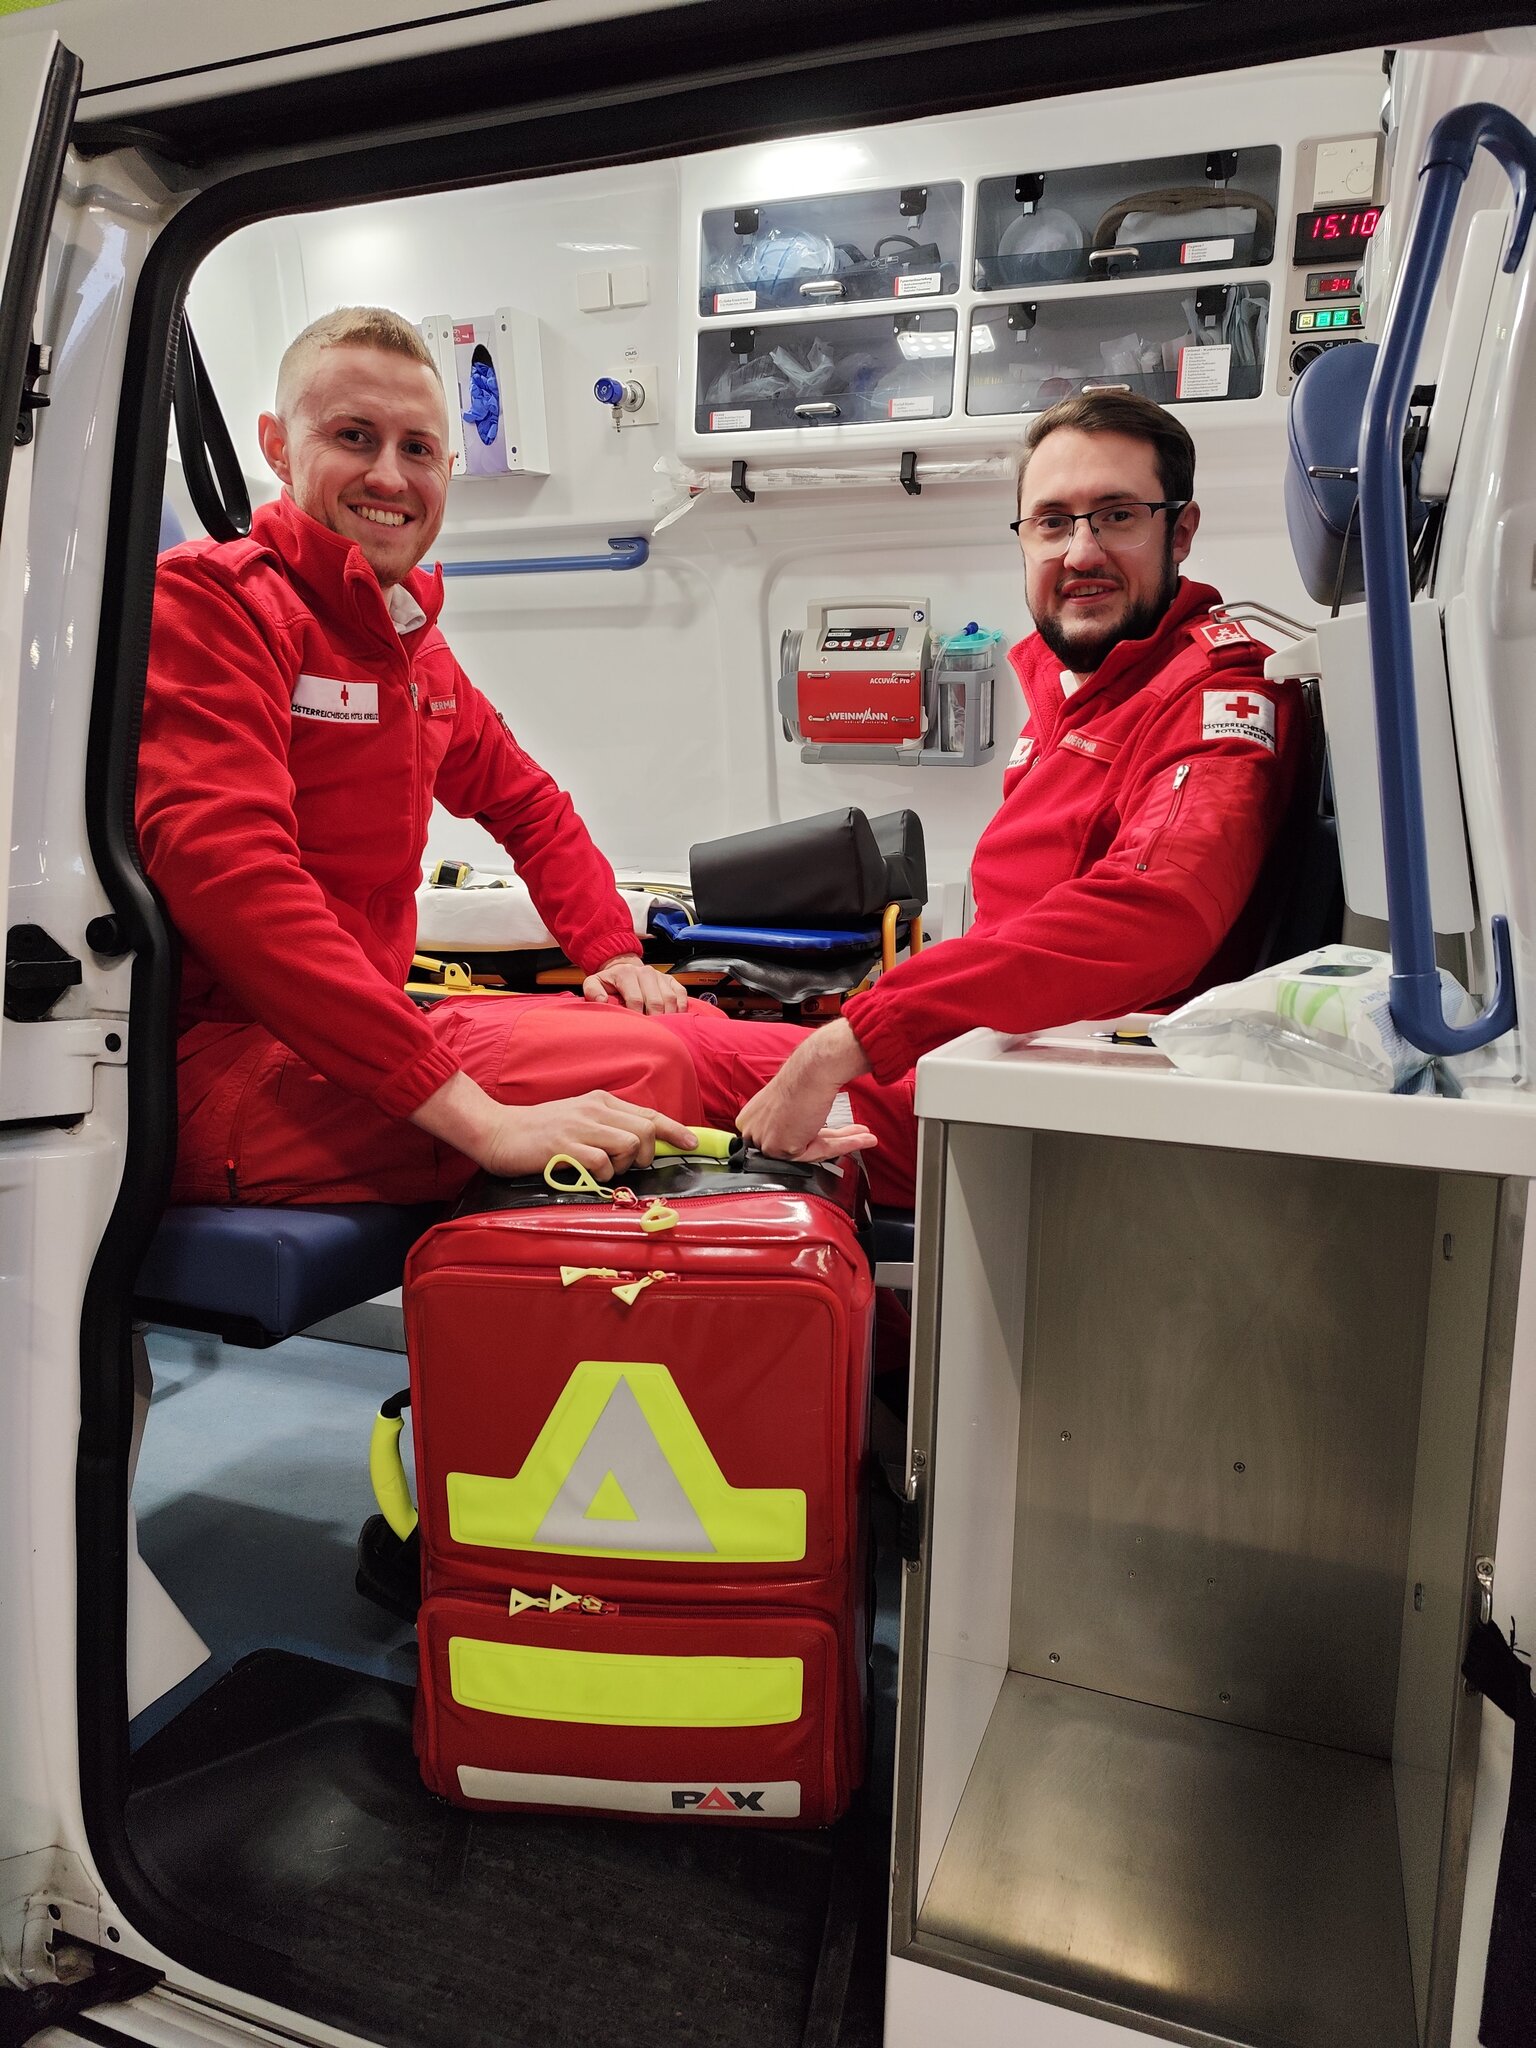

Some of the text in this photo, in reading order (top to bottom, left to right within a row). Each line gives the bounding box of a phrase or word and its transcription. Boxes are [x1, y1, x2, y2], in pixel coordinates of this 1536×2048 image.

[870, 677, 898, 685] ACCUVAC
[829, 707, 888, 724] WEINMANN
[671, 1786, 765, 1811] PAX
